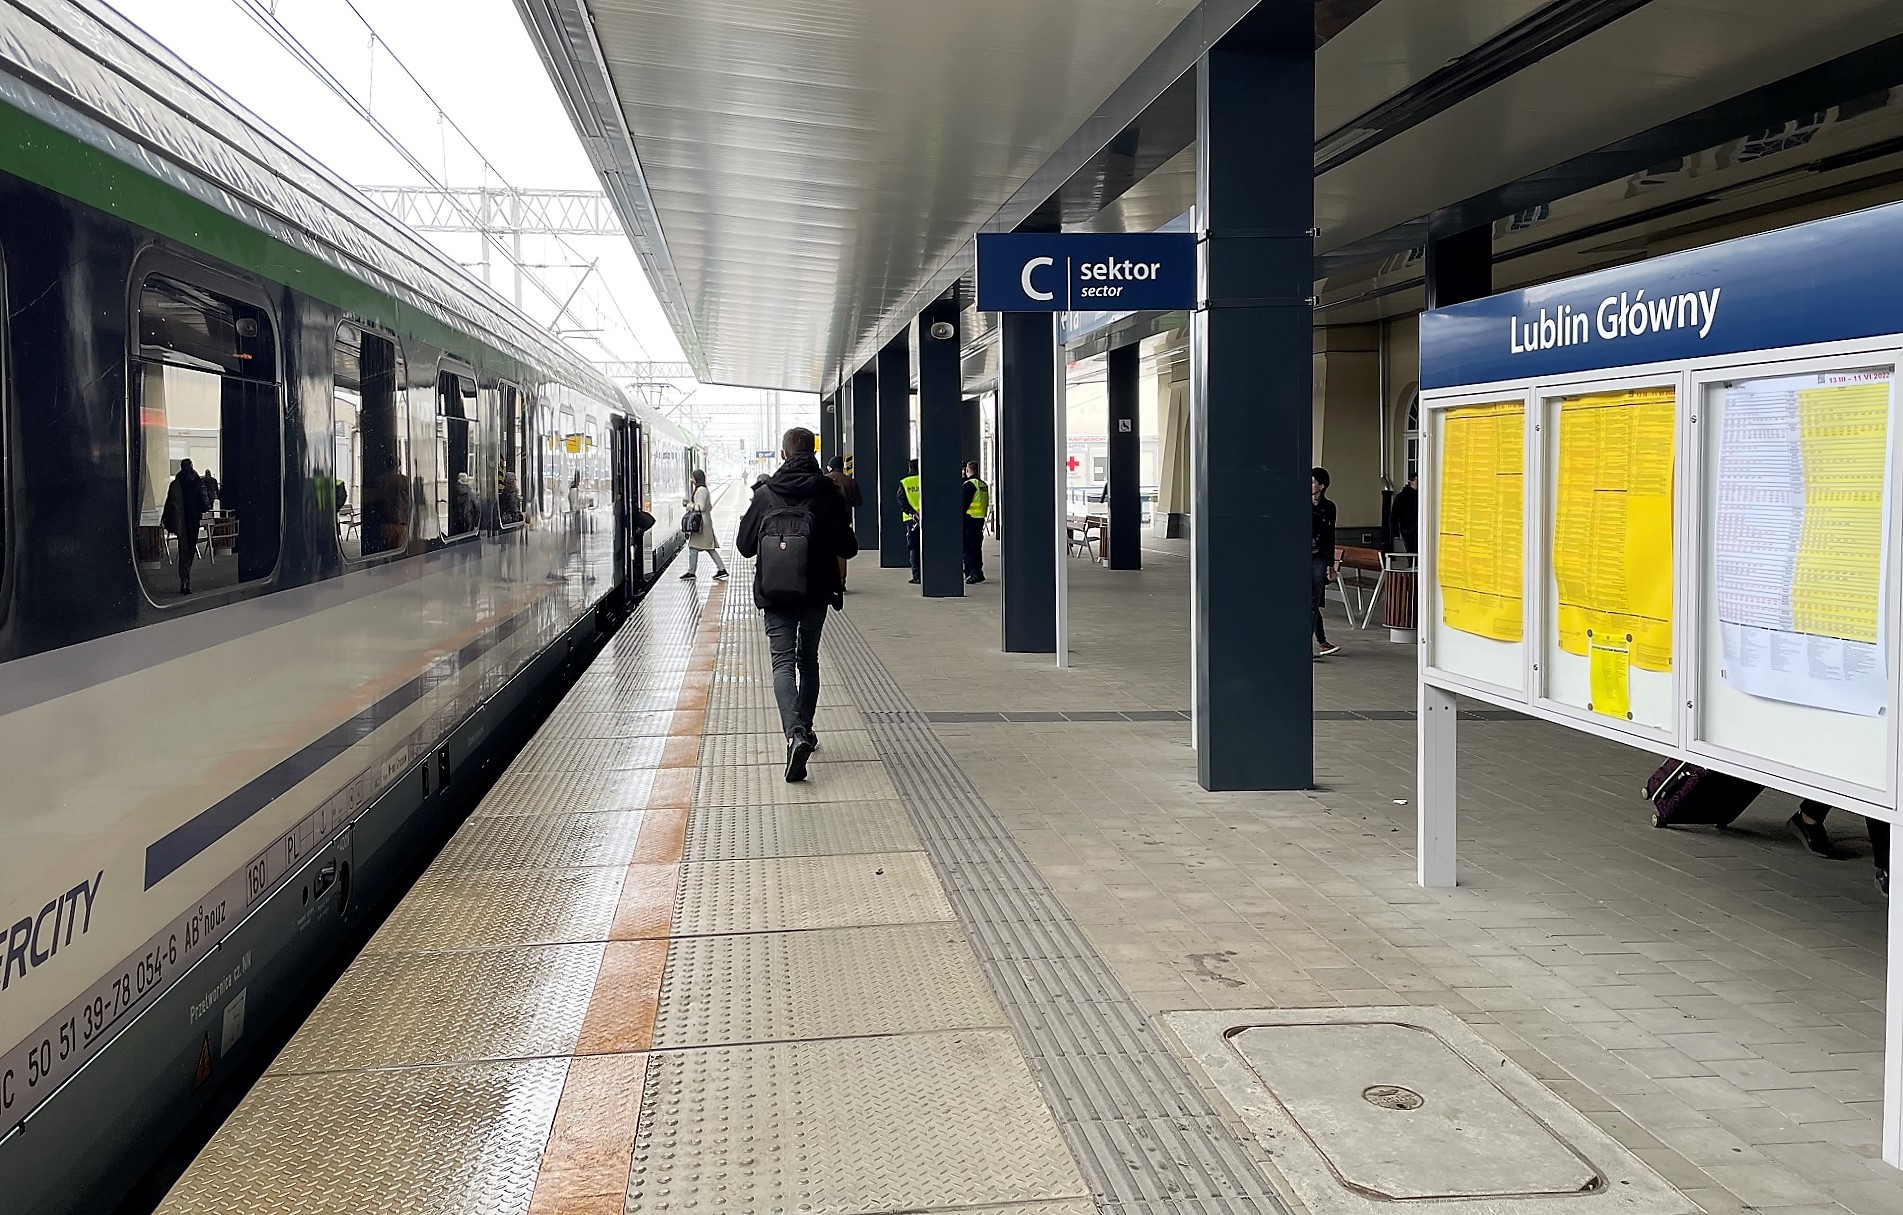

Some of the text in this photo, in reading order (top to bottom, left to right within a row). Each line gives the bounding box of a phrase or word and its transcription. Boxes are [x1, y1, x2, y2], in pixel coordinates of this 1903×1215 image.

[1020, 256, 1054, 302] C
[1080, 256, 1161, 281] sektor
[1080, 285, 1124, 298] sector
[1510, 288, 1721, 354] Lublin Główny
[28, 1038, 51, 1088] 50
[59, 1015, 76, 1061] 51
[83, 973, 131, 1040] 39-78
[137, 933, 177, 994] 054-6
[248, 859, 266, 898] 160
[287, 832, 300, 865] PL
[190, 974, 232, 1025] Przetwornica
